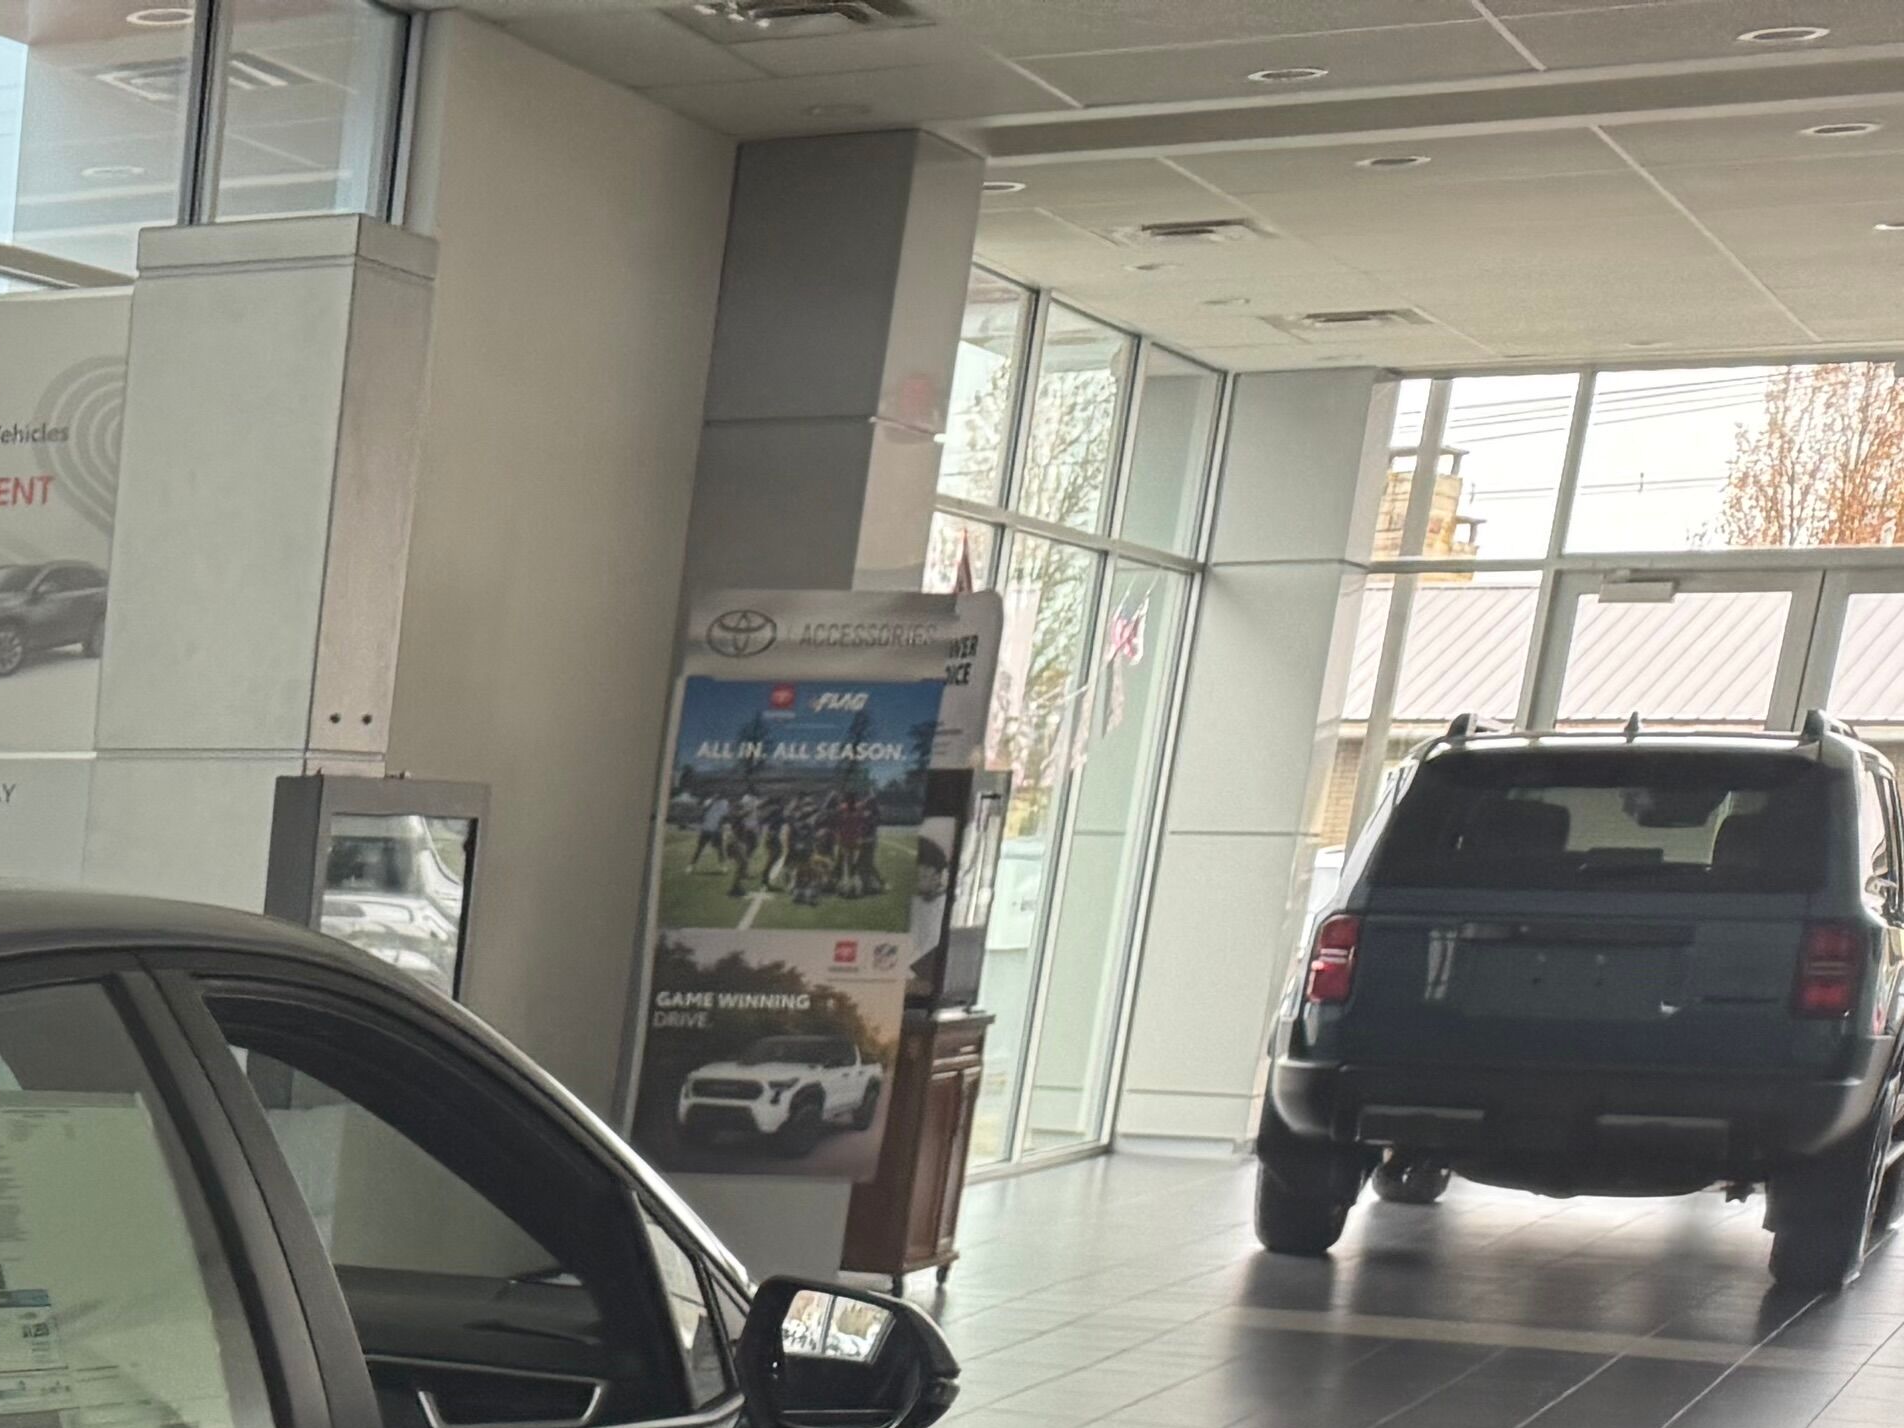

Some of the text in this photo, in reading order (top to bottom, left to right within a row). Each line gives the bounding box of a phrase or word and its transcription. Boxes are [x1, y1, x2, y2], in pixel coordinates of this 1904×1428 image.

[799, 623, 937, 648] ACCESSORIES
[697, 741, 733, 760] ALL
[773, 741, 809, 760] ALL
[815, 742, 907, 761] SEASON.
[655, 991, 811, 1009] GAME WINNING
